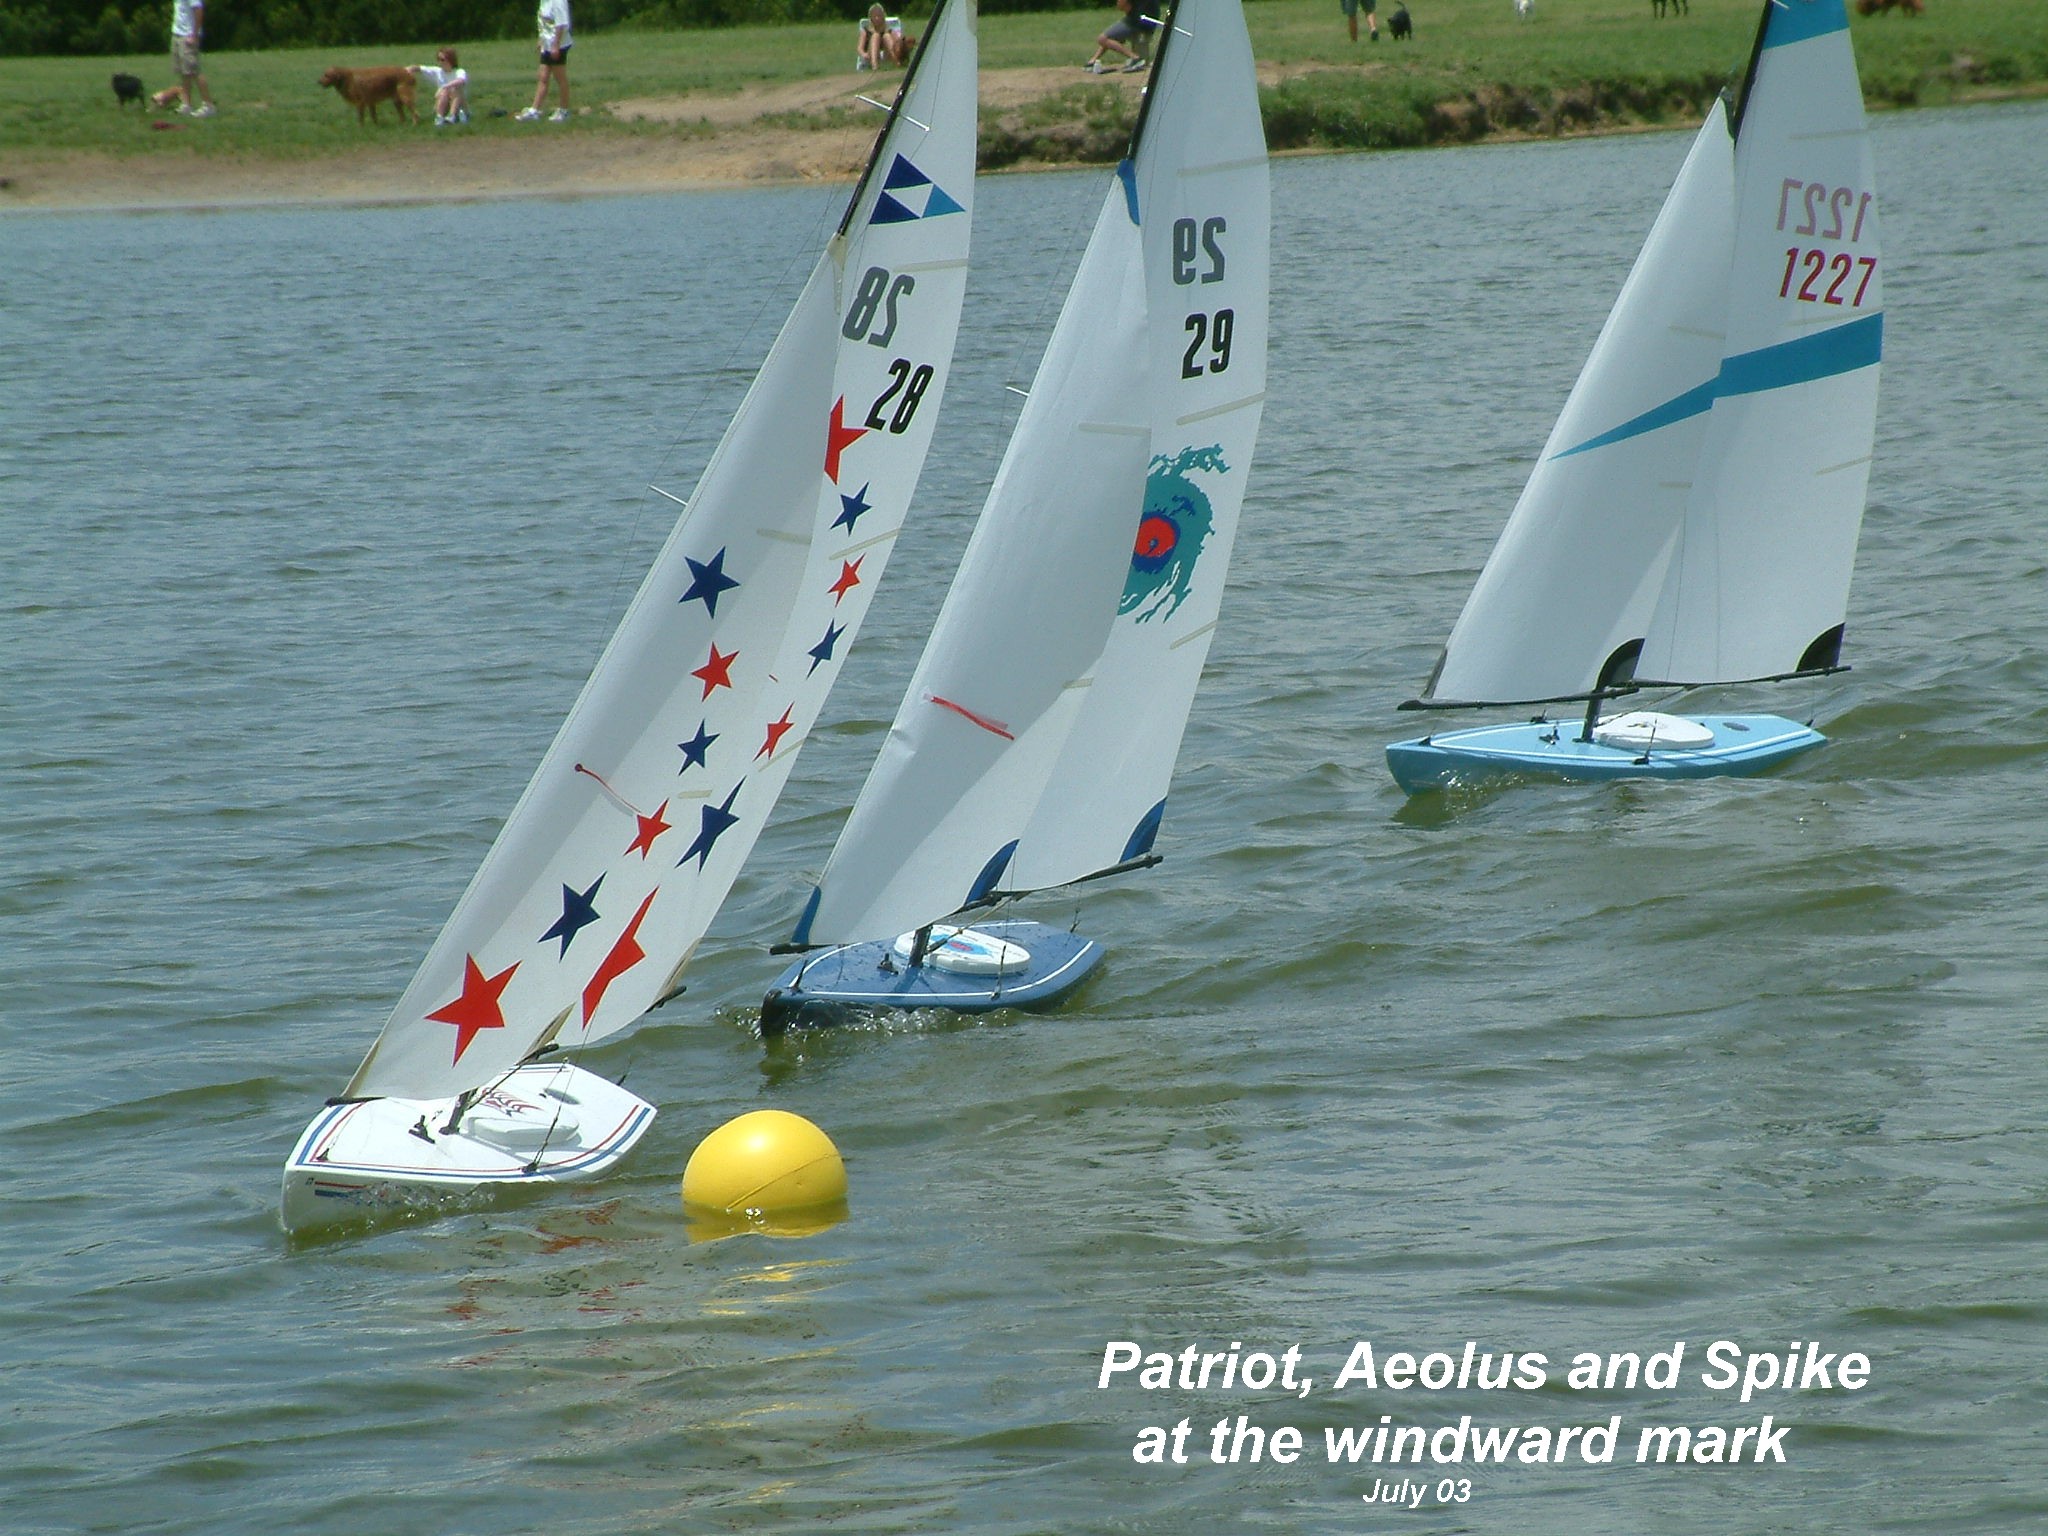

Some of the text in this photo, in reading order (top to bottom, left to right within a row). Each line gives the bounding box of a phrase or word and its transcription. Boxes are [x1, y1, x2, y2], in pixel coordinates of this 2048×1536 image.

[1779, 247, 1877, 307] 1227
[1181, 309, 1234, 379] 29
[864, 358, 935, 434] 28
